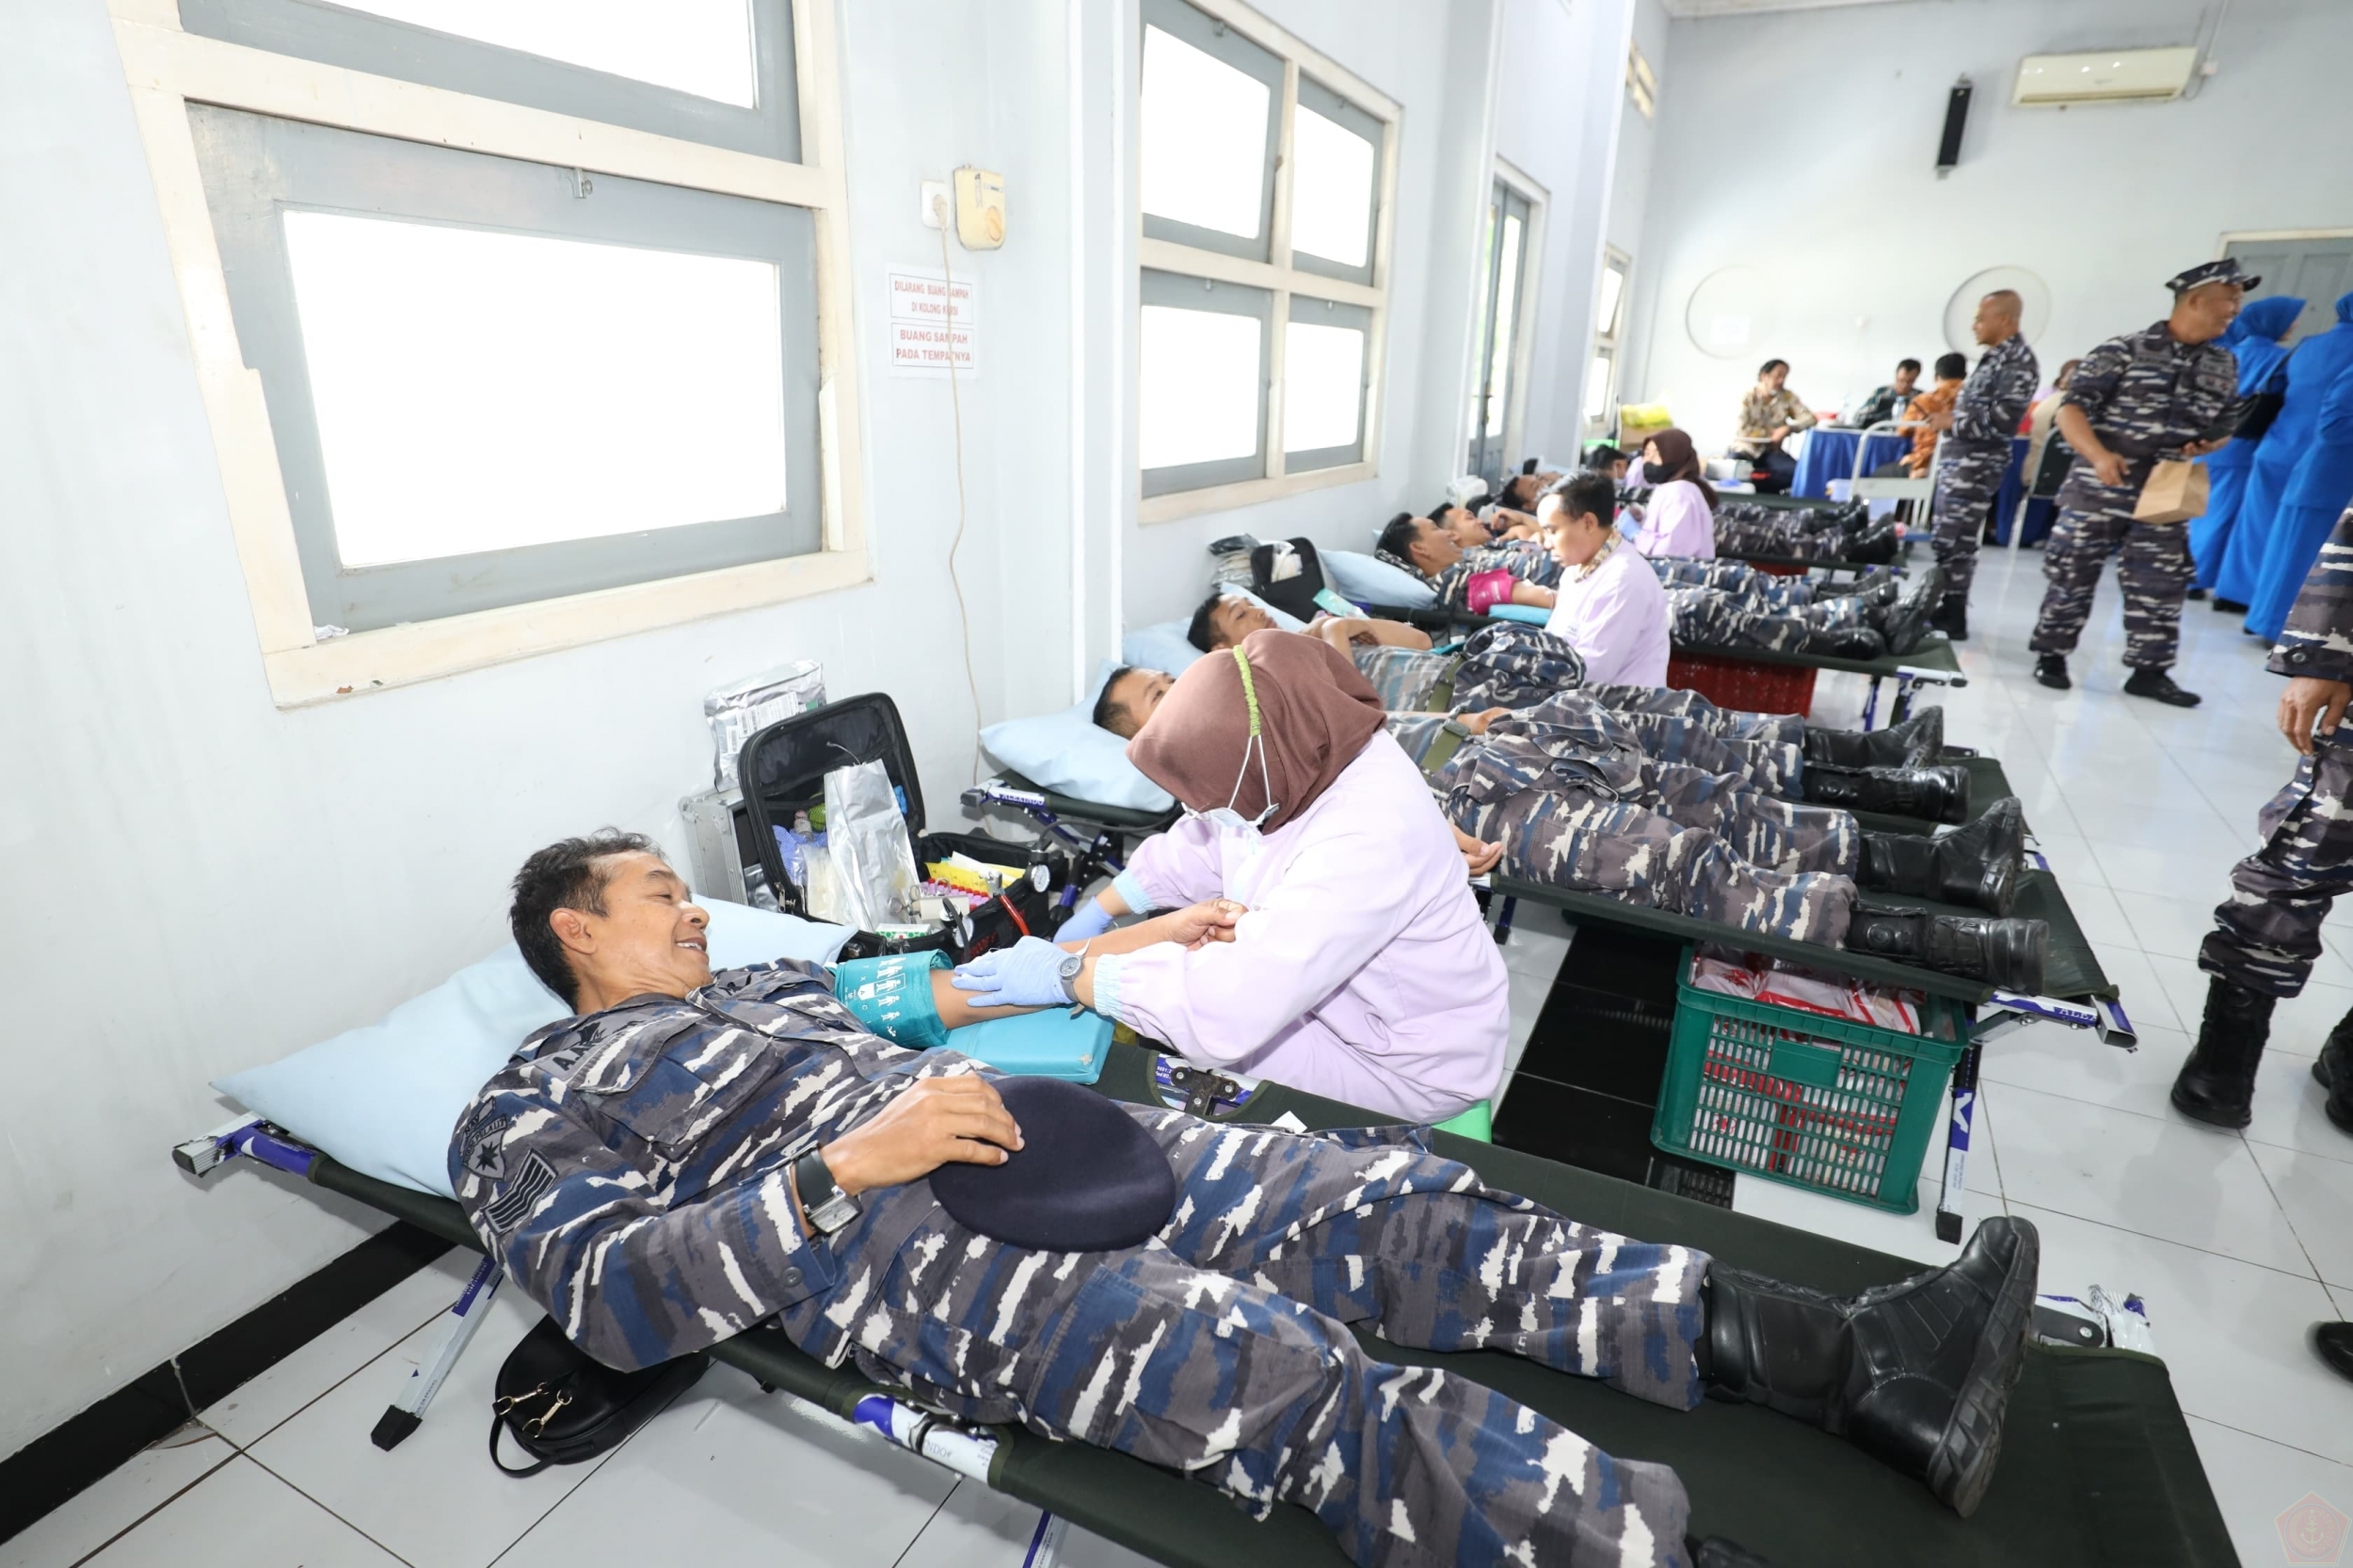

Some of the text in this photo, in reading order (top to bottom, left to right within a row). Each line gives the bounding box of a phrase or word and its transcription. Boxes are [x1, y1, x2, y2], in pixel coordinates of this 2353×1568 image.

[894, 280, 969, 299] DILARANG BUANG AMPAH
[911, 301, 958, 315] DI KOLONG KRSI
[900, 329, 932, 342] BUANG
[896, 348, 970, 361] PADA TEMPANYA
